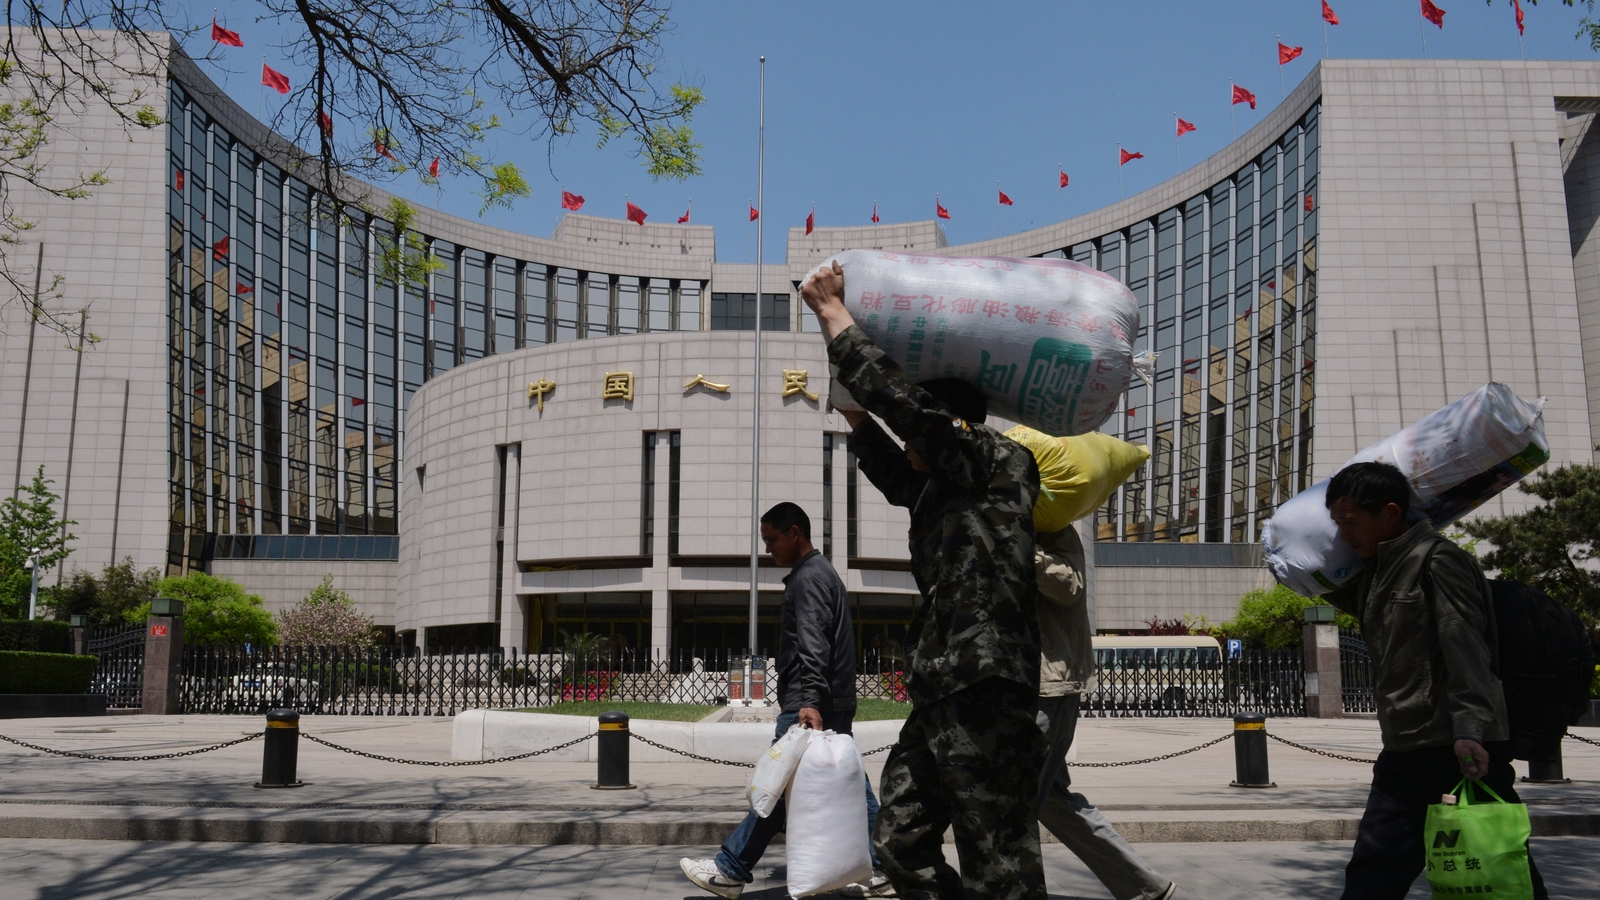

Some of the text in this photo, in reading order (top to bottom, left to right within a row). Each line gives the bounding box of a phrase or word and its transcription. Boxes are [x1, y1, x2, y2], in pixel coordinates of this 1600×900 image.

[528, 369, 820, 412] 中国人民
[1230, 641, 1239, 652] P
